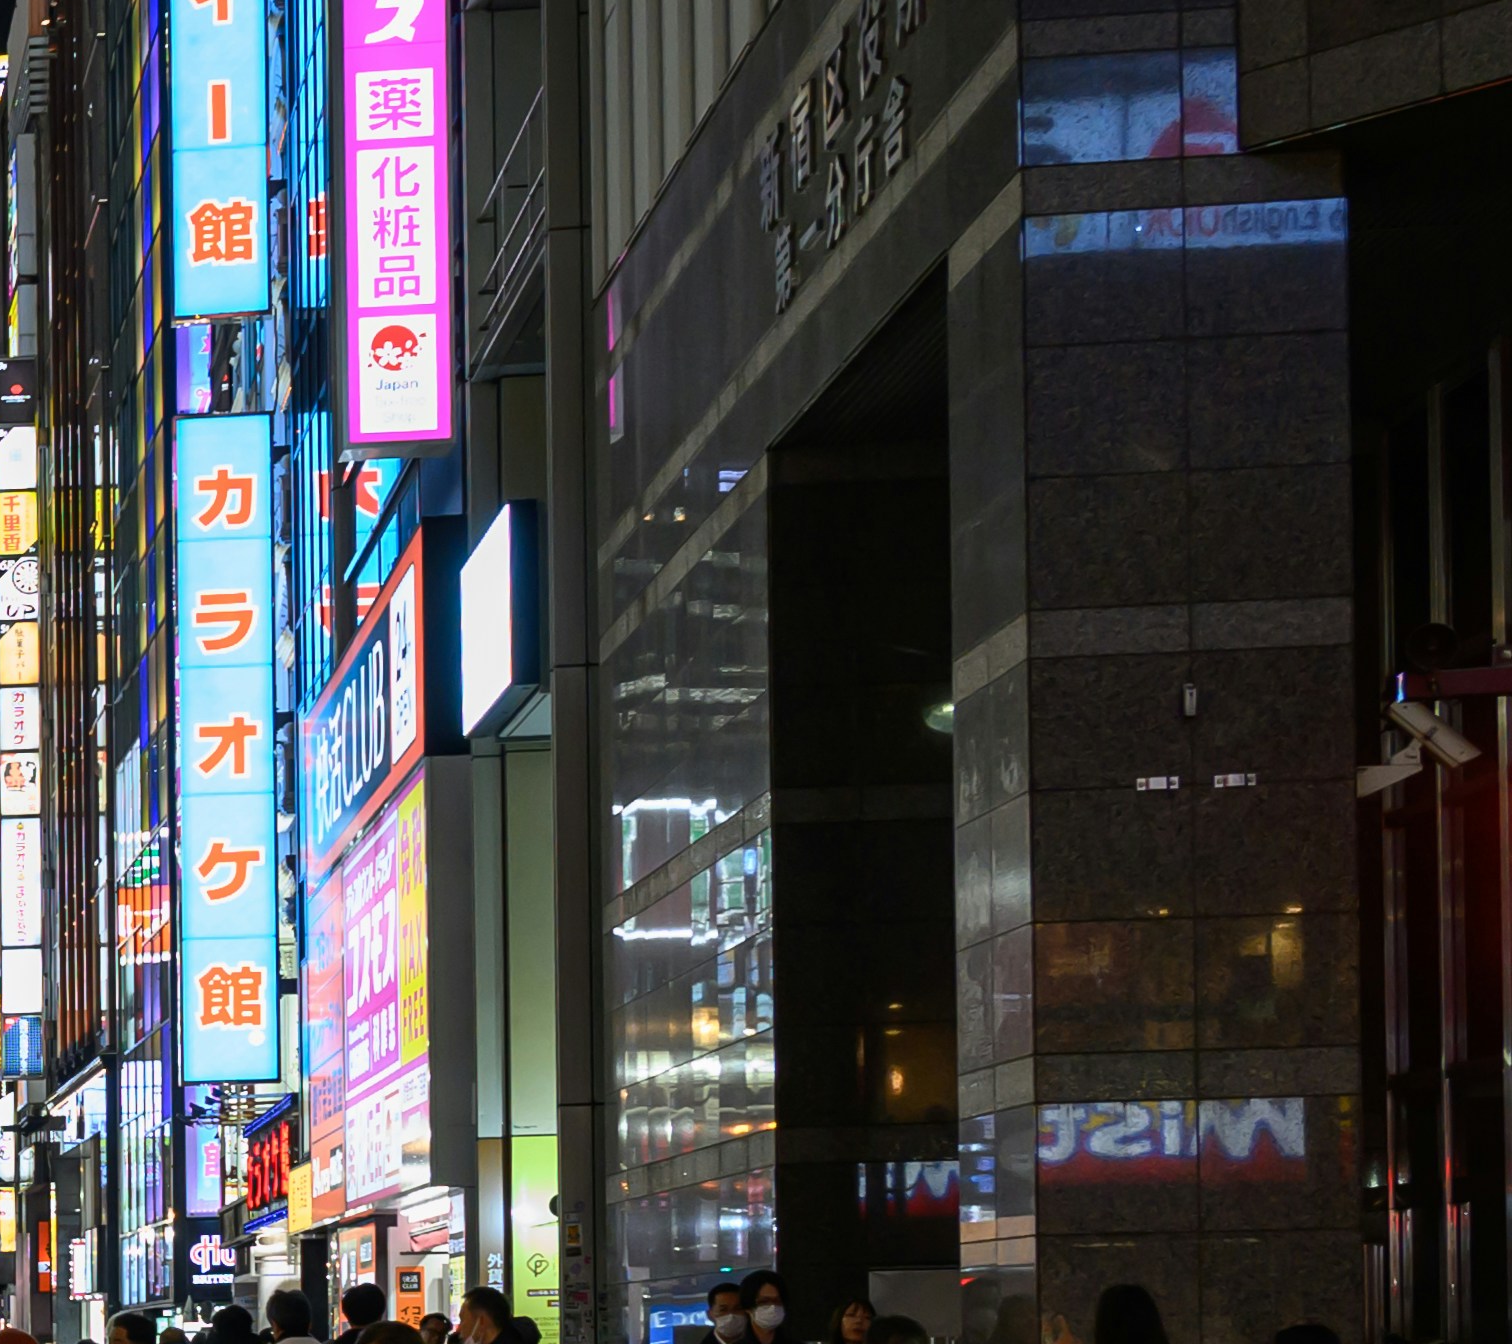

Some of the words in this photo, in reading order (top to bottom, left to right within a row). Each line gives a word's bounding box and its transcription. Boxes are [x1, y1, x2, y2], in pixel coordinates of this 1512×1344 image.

[368, 77, 423, 131] 薬
[371, 154, 422, 301] 化粧品
[772, 75, 911, 315] 第一分庁舎
[375, 376, 419, 392] Japan
[3, 493, 20, 553] 千里香
[11, 691, 26, 746] カラオケ
[193, 466, 265, 1029] カラオケ館
[342, 639, 386, 812] CLUB
[346, 887, 396, 1017] コスモス
[402, 910, 424, 986] TAX
[402, 986, 425, 1047] FREE
